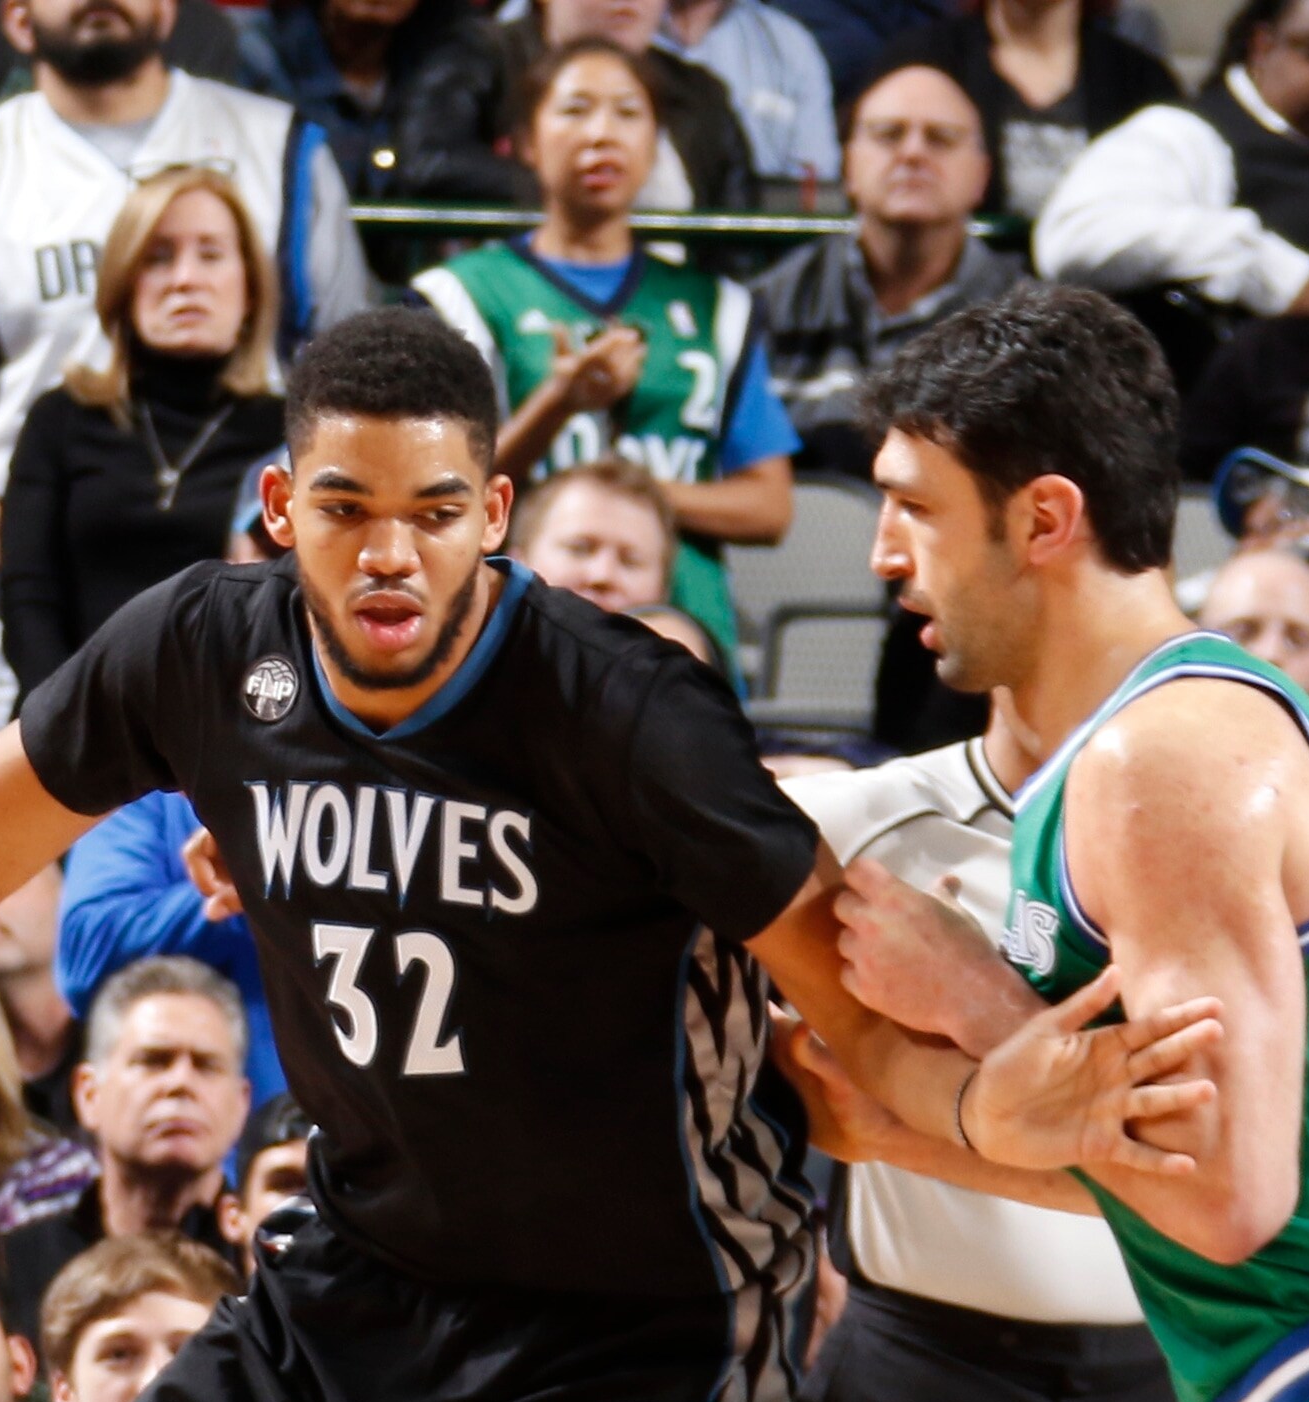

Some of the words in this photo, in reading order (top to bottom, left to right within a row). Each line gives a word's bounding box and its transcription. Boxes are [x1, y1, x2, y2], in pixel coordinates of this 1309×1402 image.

[246, 674, 294, 701] FLIP
[243, 778, 540, 920] WOLVES
[311, 919, 469, 1078] 32
